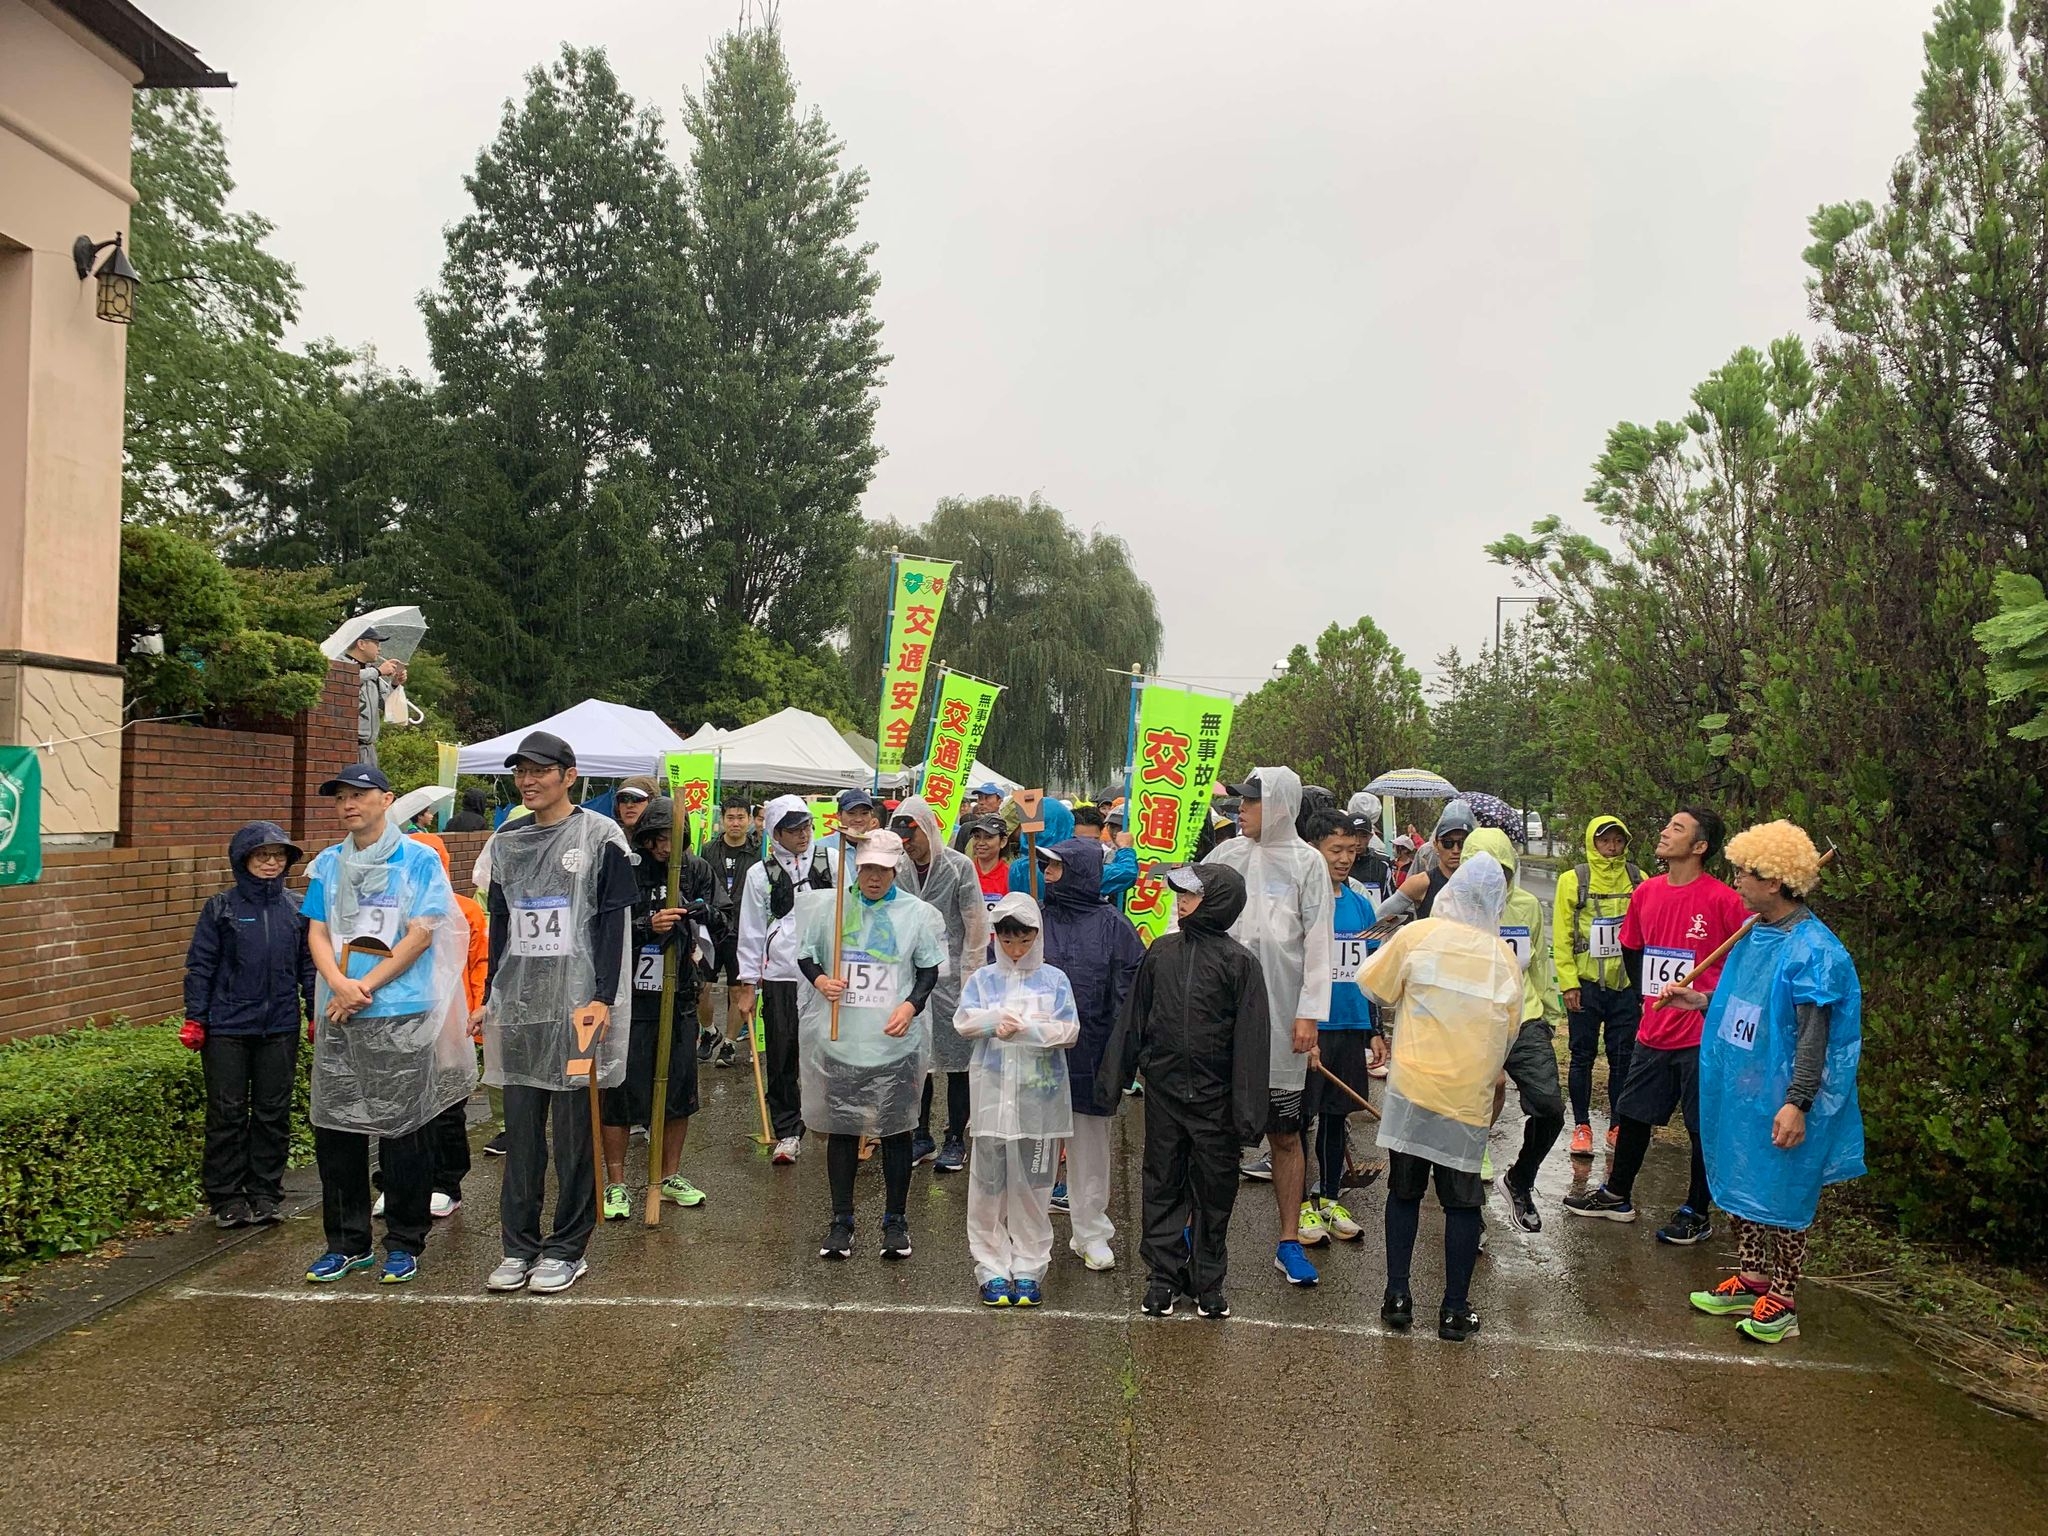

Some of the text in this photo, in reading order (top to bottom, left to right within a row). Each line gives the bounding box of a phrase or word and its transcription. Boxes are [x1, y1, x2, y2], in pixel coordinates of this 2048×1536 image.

[884, 604, 936, 748] 交通安全
[1127, 726, 1192, 950] 交通安
[517, 910, 562, 938] 134
[1600, 924, 1624, 945] 11
[531, 943, 560, 952] PACO
[846, 963, 889, 992] 152
[1650, 957, 1686, 983] 166
[859, 995, 885, 1003] PACO
